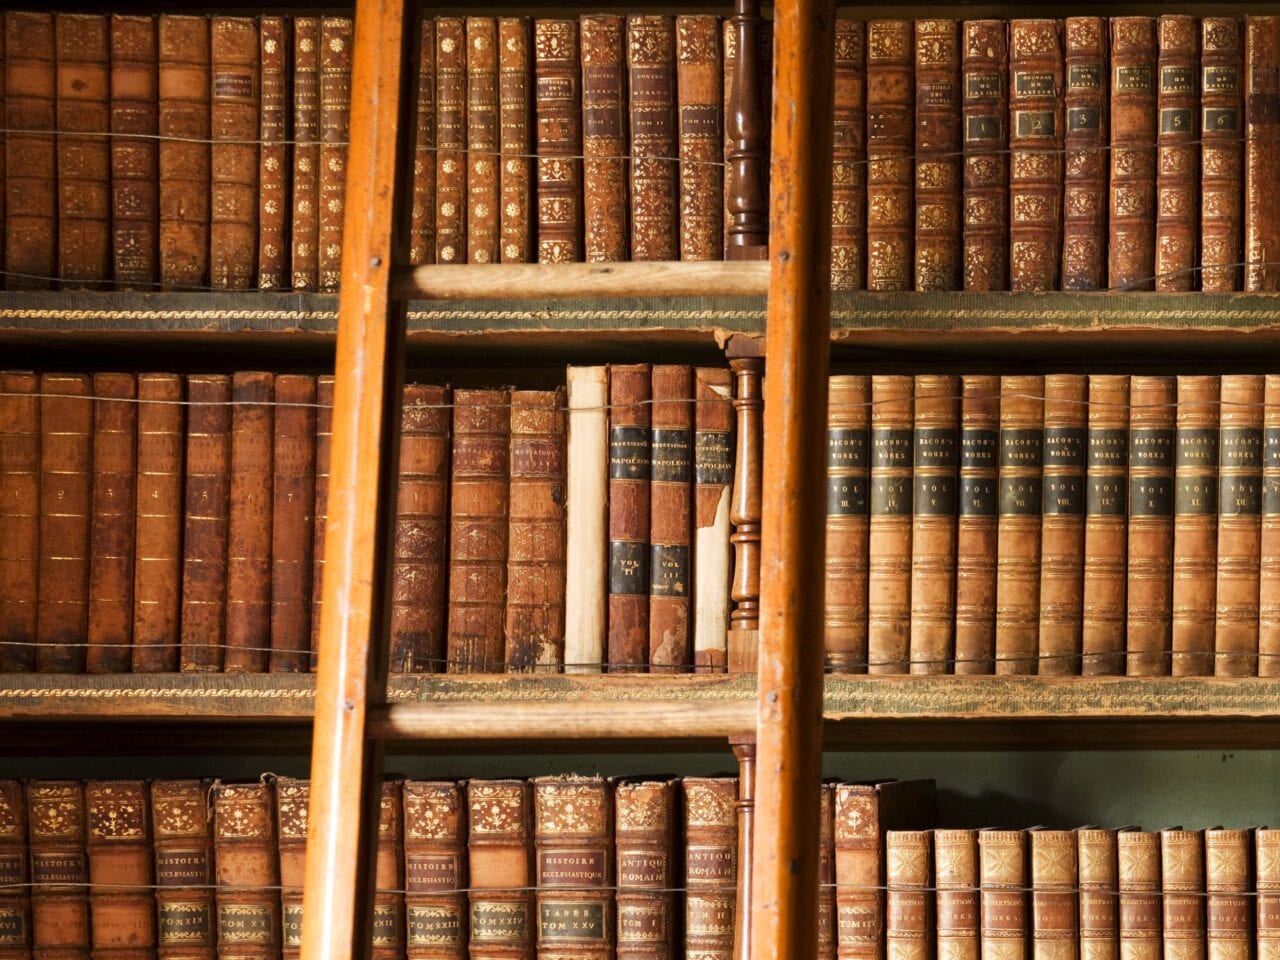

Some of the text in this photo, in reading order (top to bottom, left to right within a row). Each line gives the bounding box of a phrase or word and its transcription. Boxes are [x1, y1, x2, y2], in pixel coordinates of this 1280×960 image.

[1033, 120, 1041, 129] 2
[1080, 114, 1087, 125] 3
[1174, 116, 1181, 126] 5
[1217, 115, 1228, 125] 6
[542, 922, 596, 930] TOM XXV
